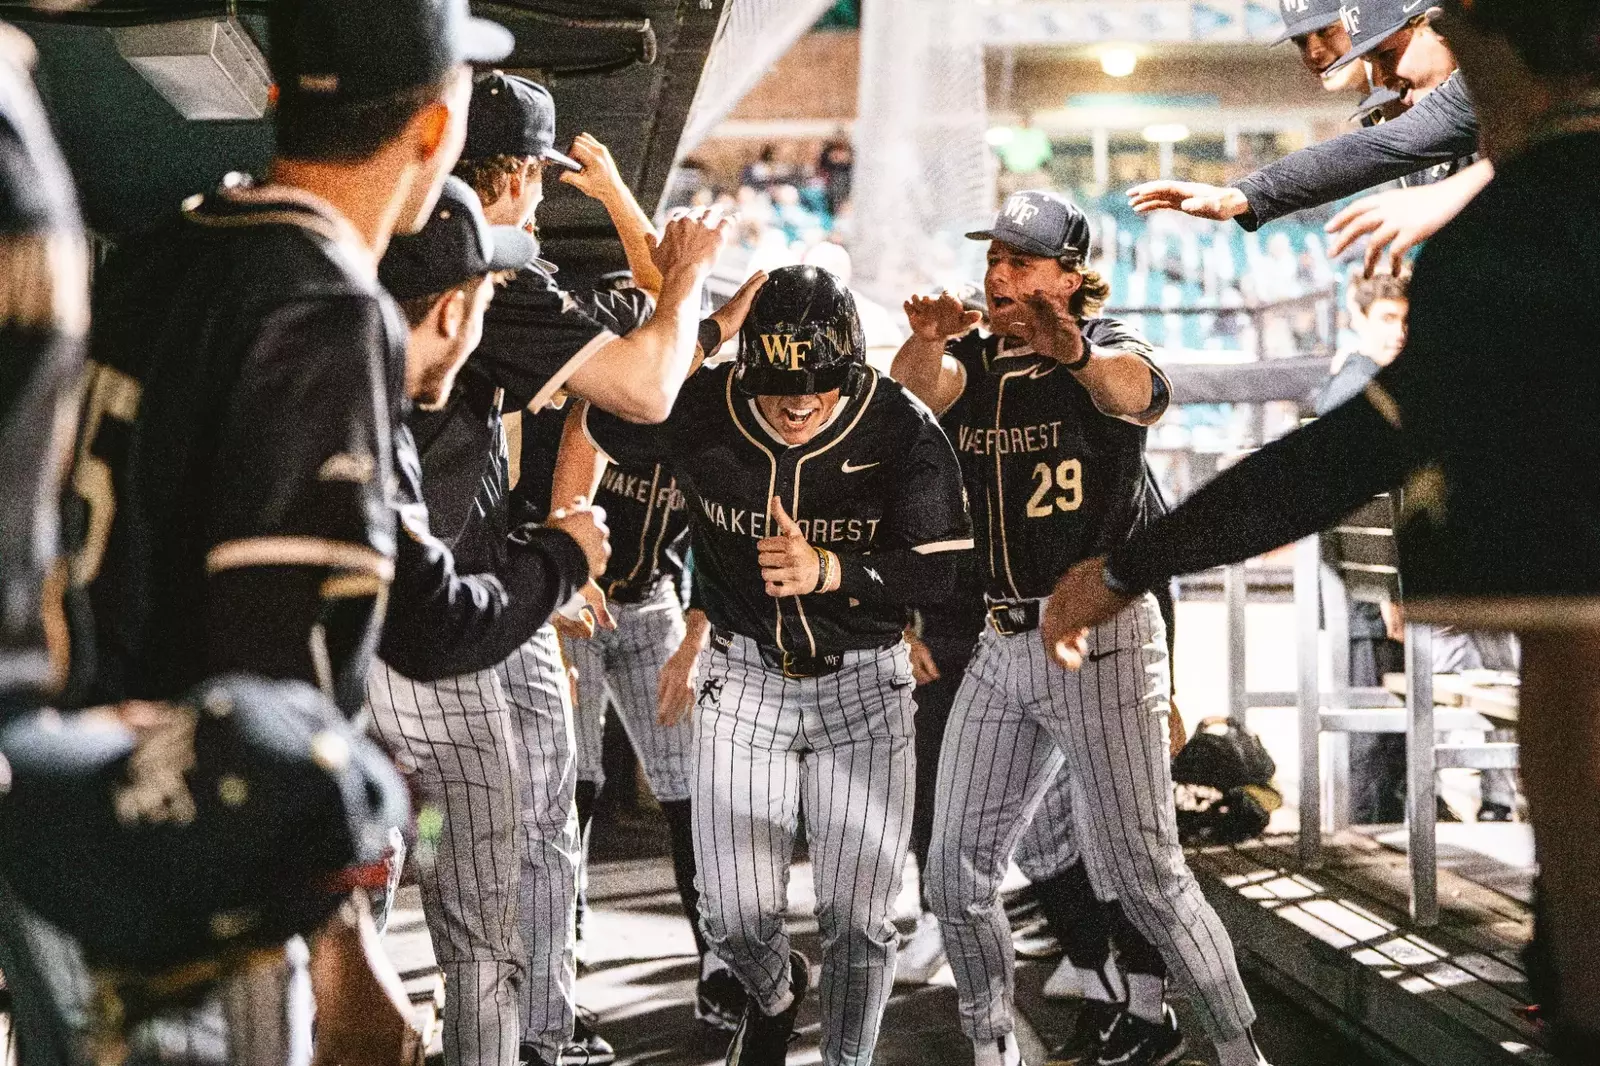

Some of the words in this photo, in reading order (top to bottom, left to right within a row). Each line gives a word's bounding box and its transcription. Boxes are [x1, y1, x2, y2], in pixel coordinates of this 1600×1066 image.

[1004, 195, 1039, 226] WF
[760, 332, 812, 371] WF
[986, 421, 1061, 455] FOREST
[1026, 458, 1083, 518] 29
[699, 495, 765, 539] WAKE
[778, 518, 881, 543] OREST
[824, 654, 840, 666] WF
